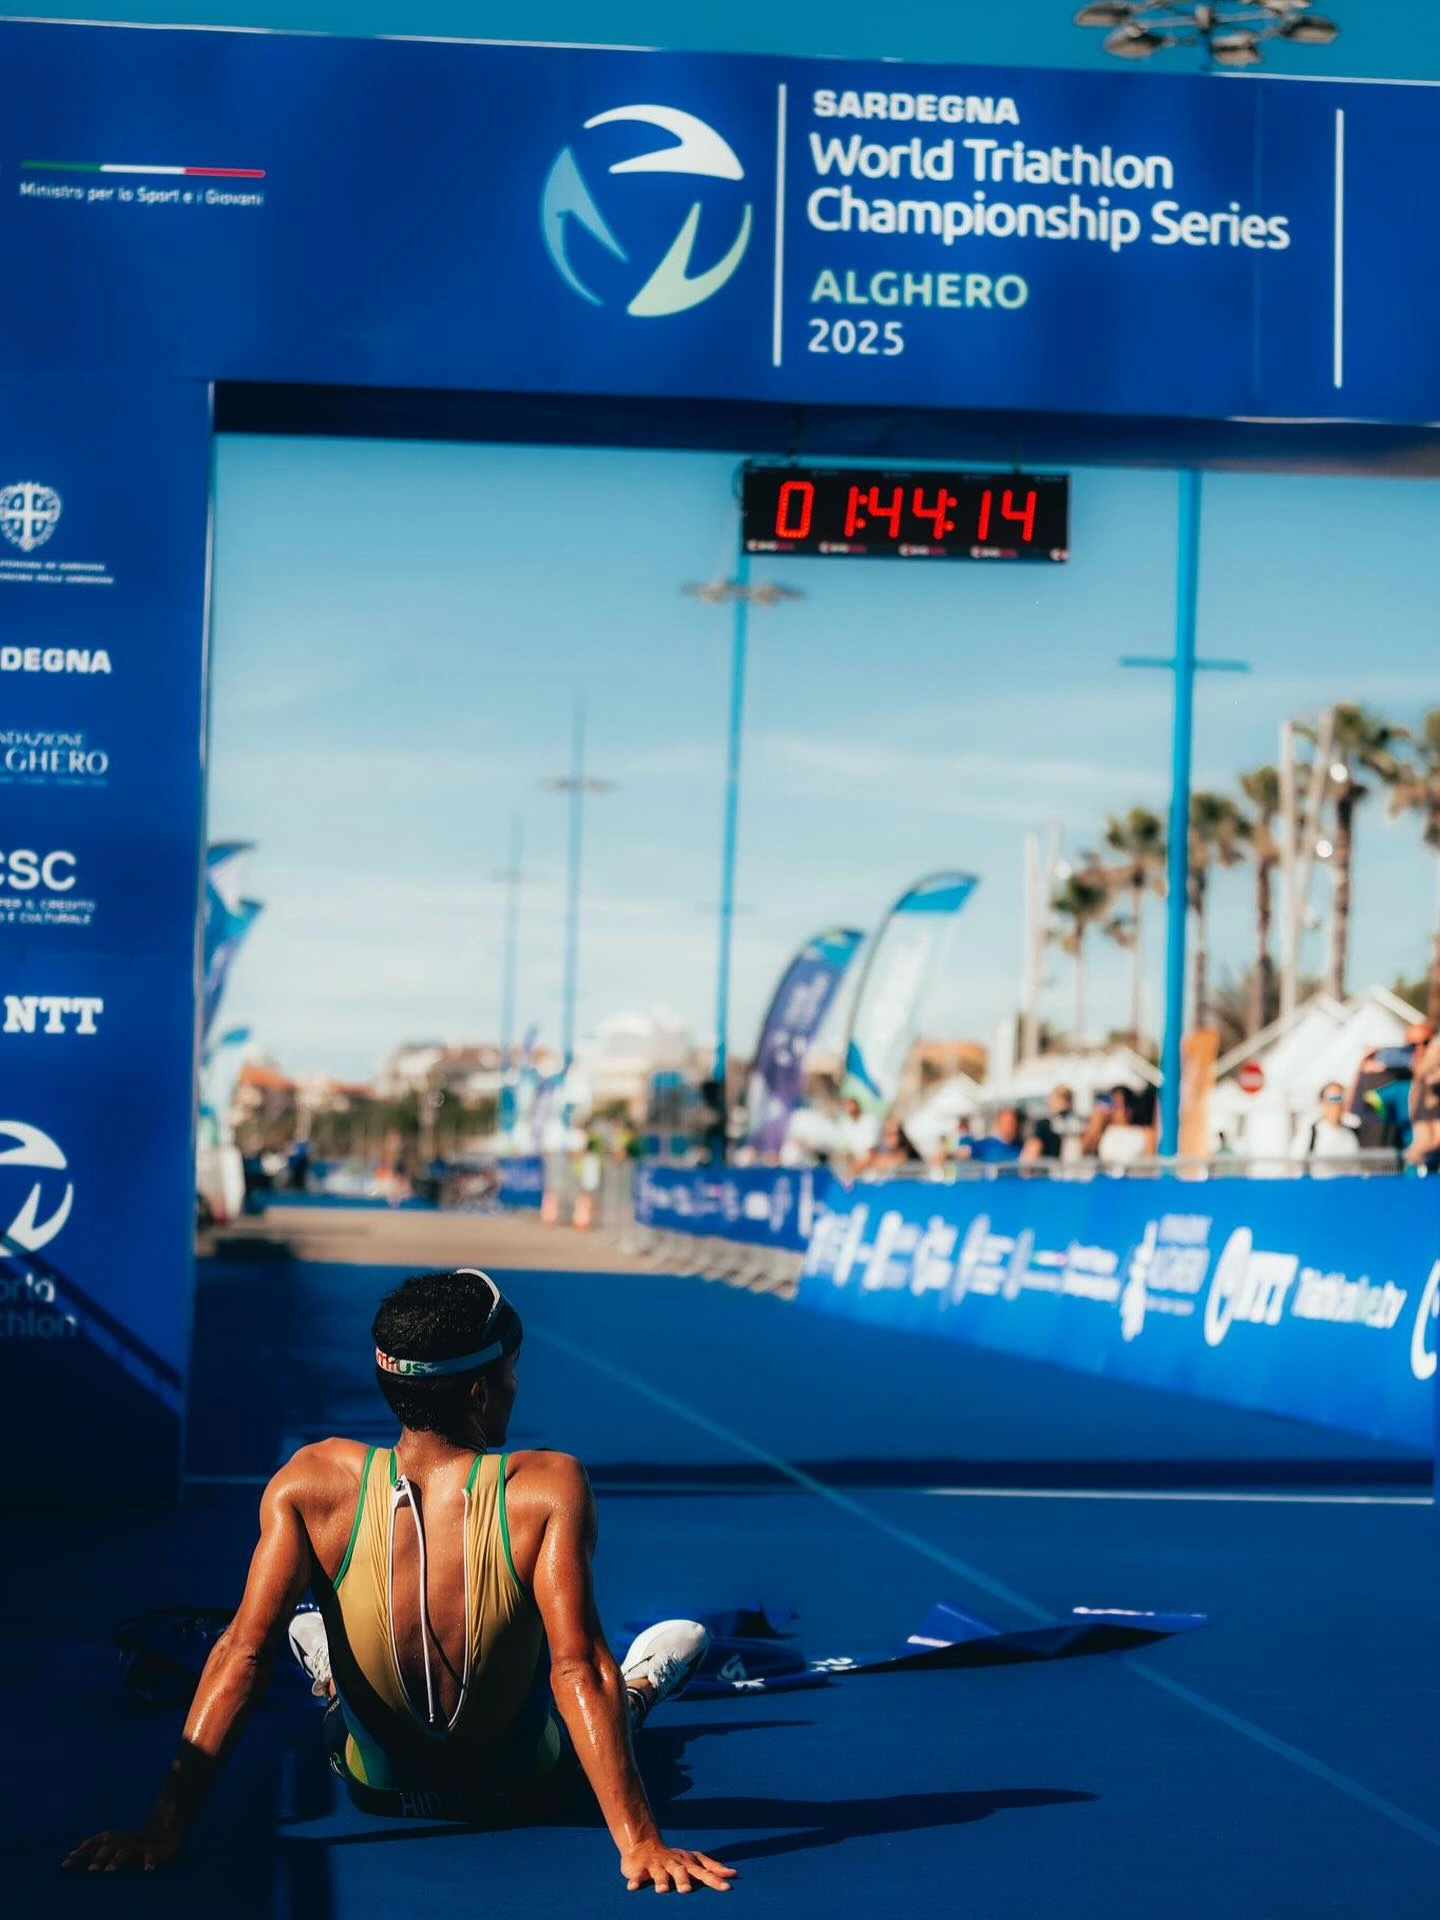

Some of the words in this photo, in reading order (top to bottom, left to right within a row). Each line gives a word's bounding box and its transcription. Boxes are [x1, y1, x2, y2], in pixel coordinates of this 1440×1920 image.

[813, 89, 1020, 125] SARDEGNA
[809, 132, 954, 181] World
[962, 138, 1174, 190] Triathlon
[87, 187, 114, 203] per
[137, 186, 180, 206] Sport
[807, 184, 1142, 253] Championship
[1151, 200, 1291, 250] Series
[811, 270, 1029, 309] ALGHERO
[808, 318, 905, 356] 2025
[0, 747, 109, 775] GHERO
[0, 849, 77, 892] SC
[2, 995, 104, 1035] NTT
